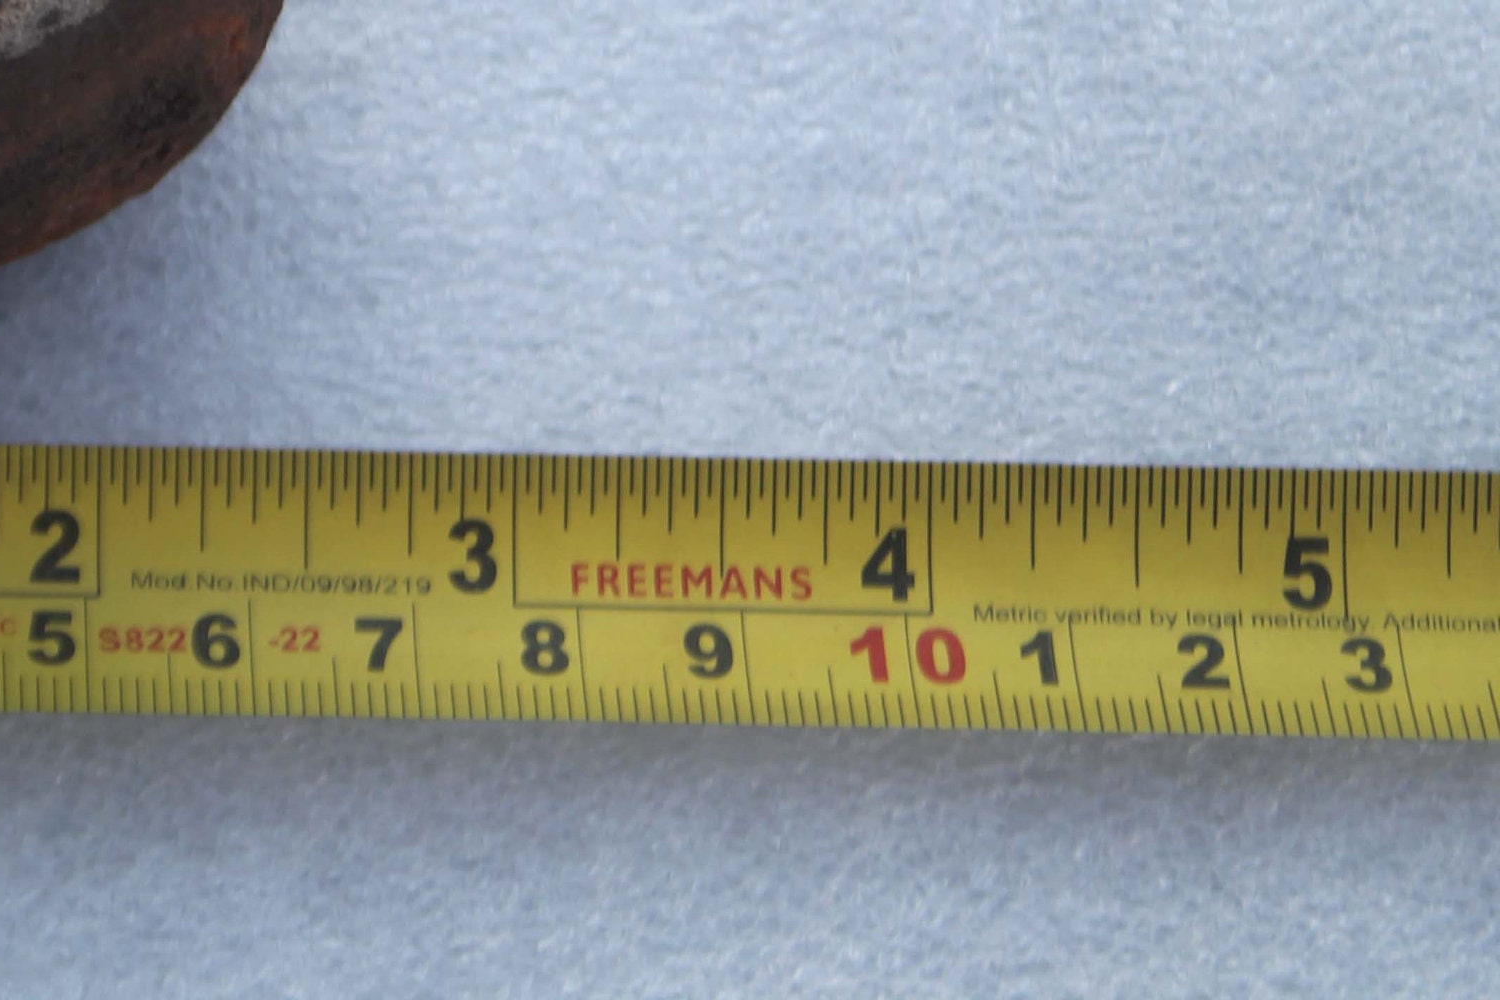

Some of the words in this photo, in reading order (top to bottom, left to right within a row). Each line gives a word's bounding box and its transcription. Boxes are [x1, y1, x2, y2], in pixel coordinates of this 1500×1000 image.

[29, 509, 81, 584] 2
[448, 518, 498, 594] 3
[861, 525, 915, 602] 4
[1282, 536, 1333, 610] 5
[571, 563, 813, 601] FREEMANS
[26, 609, 77, 667] 5
[191, 612, 241, 670] 6
[354, 617, 404, 672] 7
[1149, 607, 1179, 629] by
[519, 619, 570, 676] 8
[682, 622, 734, 680] 9
[1019, 630, 1060, 686] 1
[1176, 632, 1231, 690] 2
[1340, 637, 1393, 693] 3
